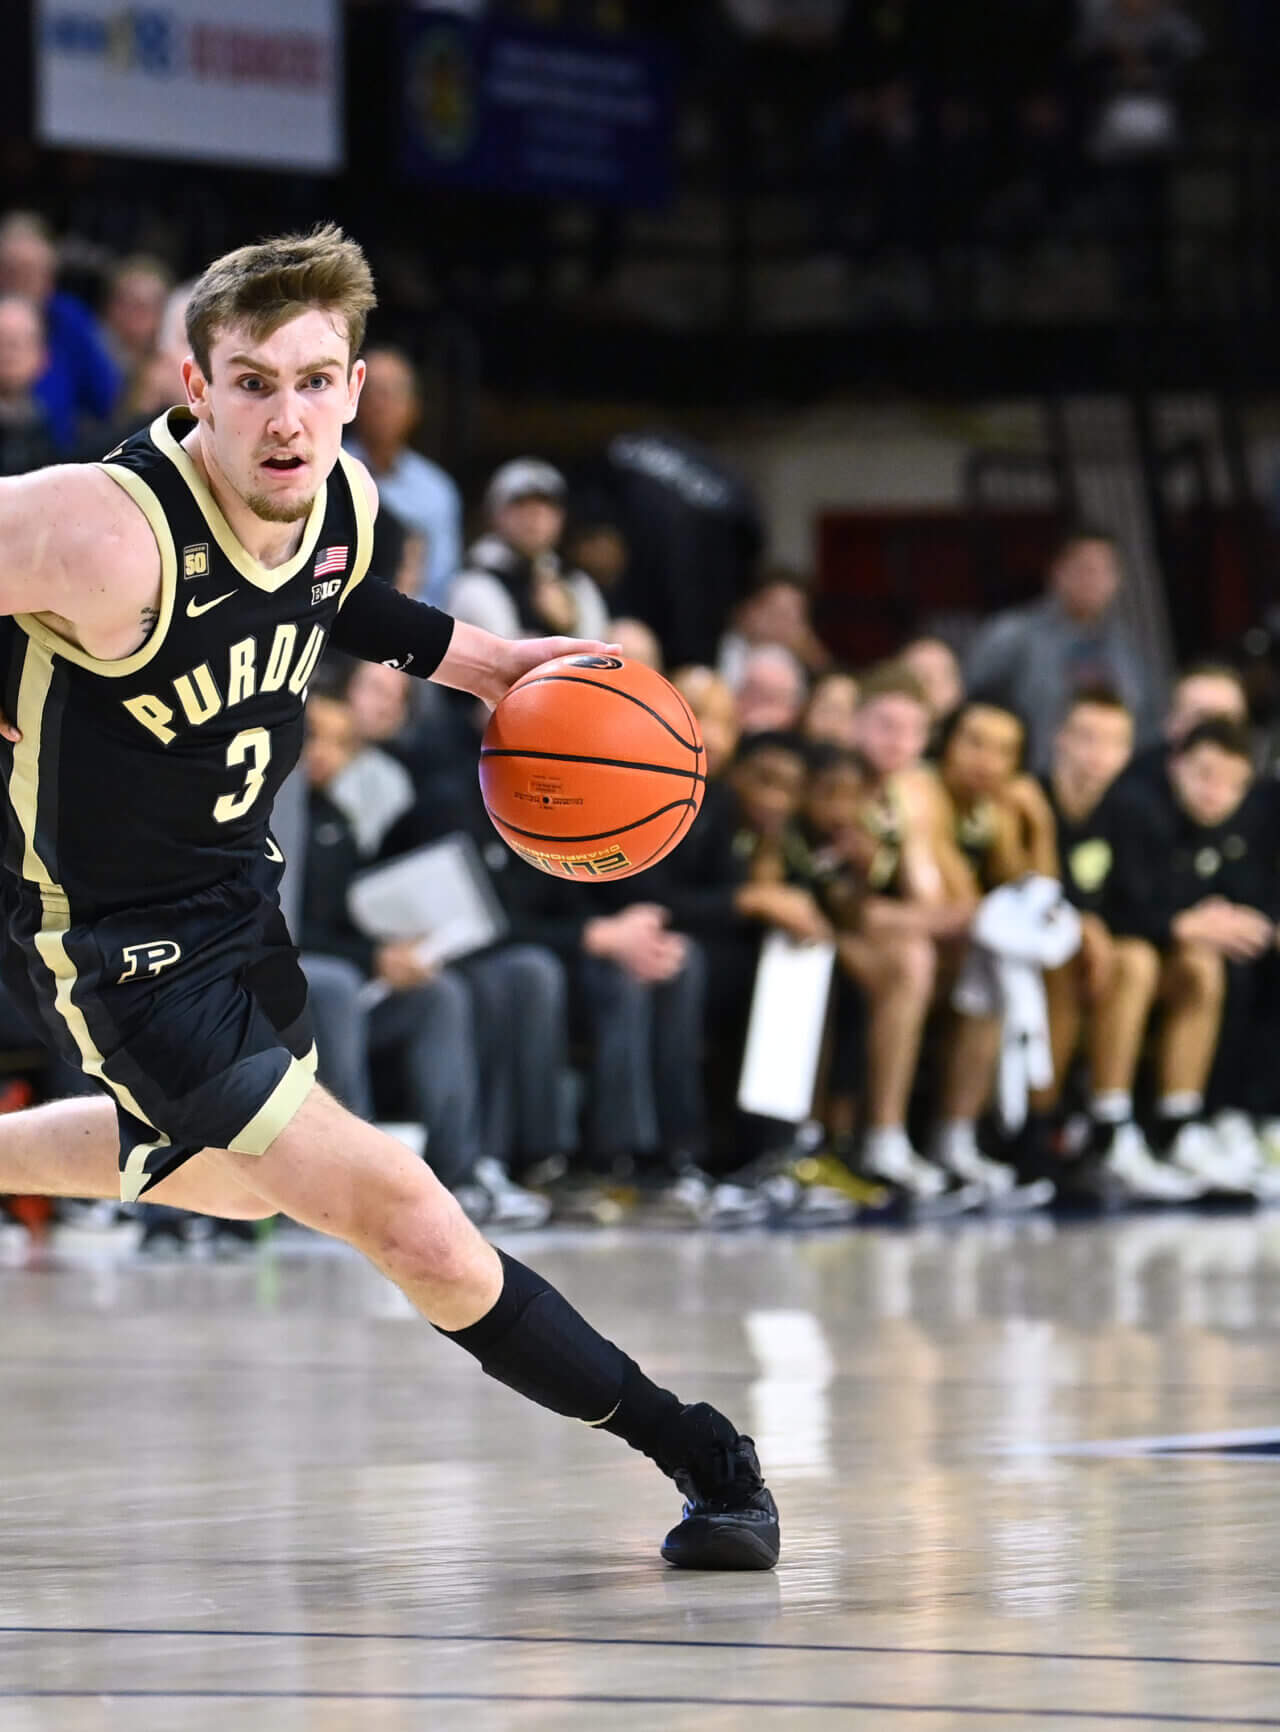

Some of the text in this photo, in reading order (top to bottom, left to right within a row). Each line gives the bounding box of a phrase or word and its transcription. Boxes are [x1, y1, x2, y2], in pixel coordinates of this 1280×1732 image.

[184, 551, 207, 576] 50
[122, 623, 325, 745] PURDU
[213, 727, 271, 823] 3
[117, 940, 181, 984] P
